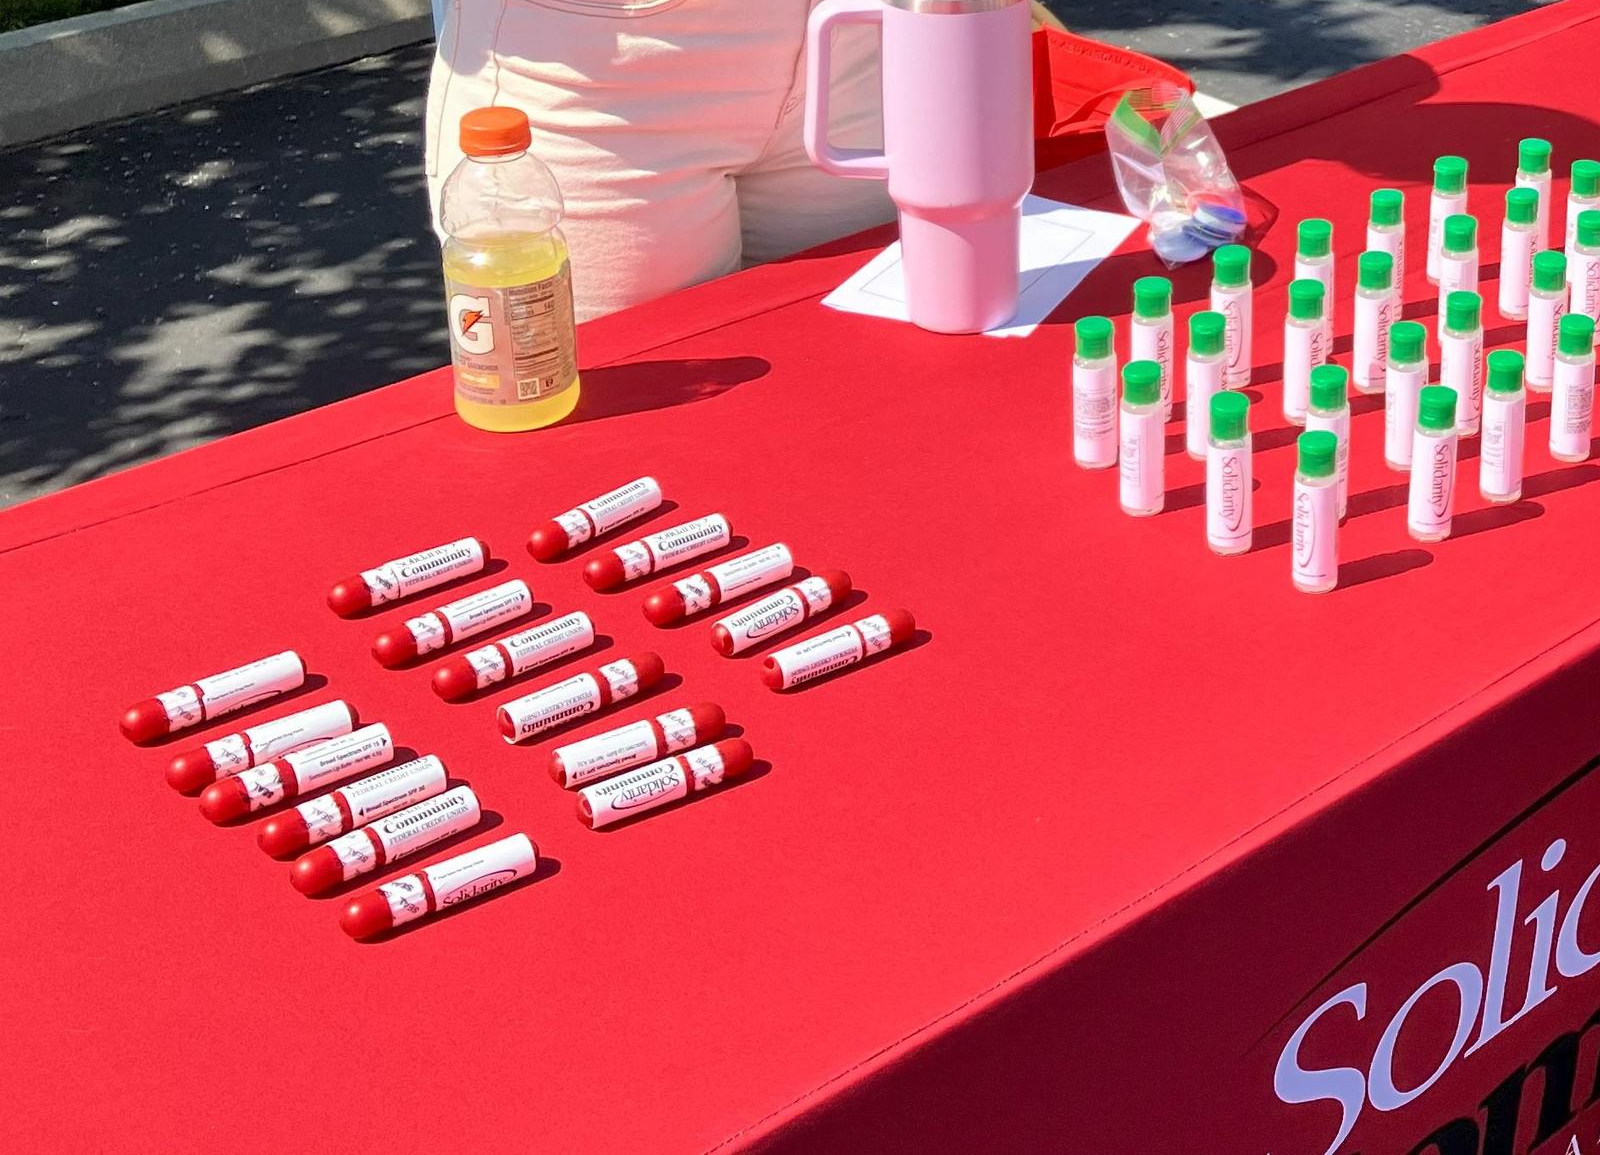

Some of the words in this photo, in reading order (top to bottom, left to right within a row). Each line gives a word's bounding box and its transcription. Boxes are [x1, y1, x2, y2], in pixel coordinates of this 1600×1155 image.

[450, 294, 495, 355] G
[1218, 457, 1237, 520] Solidarity
[1427, 444, 1448, 507] Solidarity
[657, 522, 724, 552] Community
[400, 545, 472, 579] Community
[729, 592, 794, 630] Community
[751, 602, 800, 635] Solidarity
[509, 615, 581, 649] Community
[518, 699, 595, 735] Community
[593, 762, 674, 798] Community
[616, 771, 680, 805] Solidarity
[382, 793, 466, 835] Community
